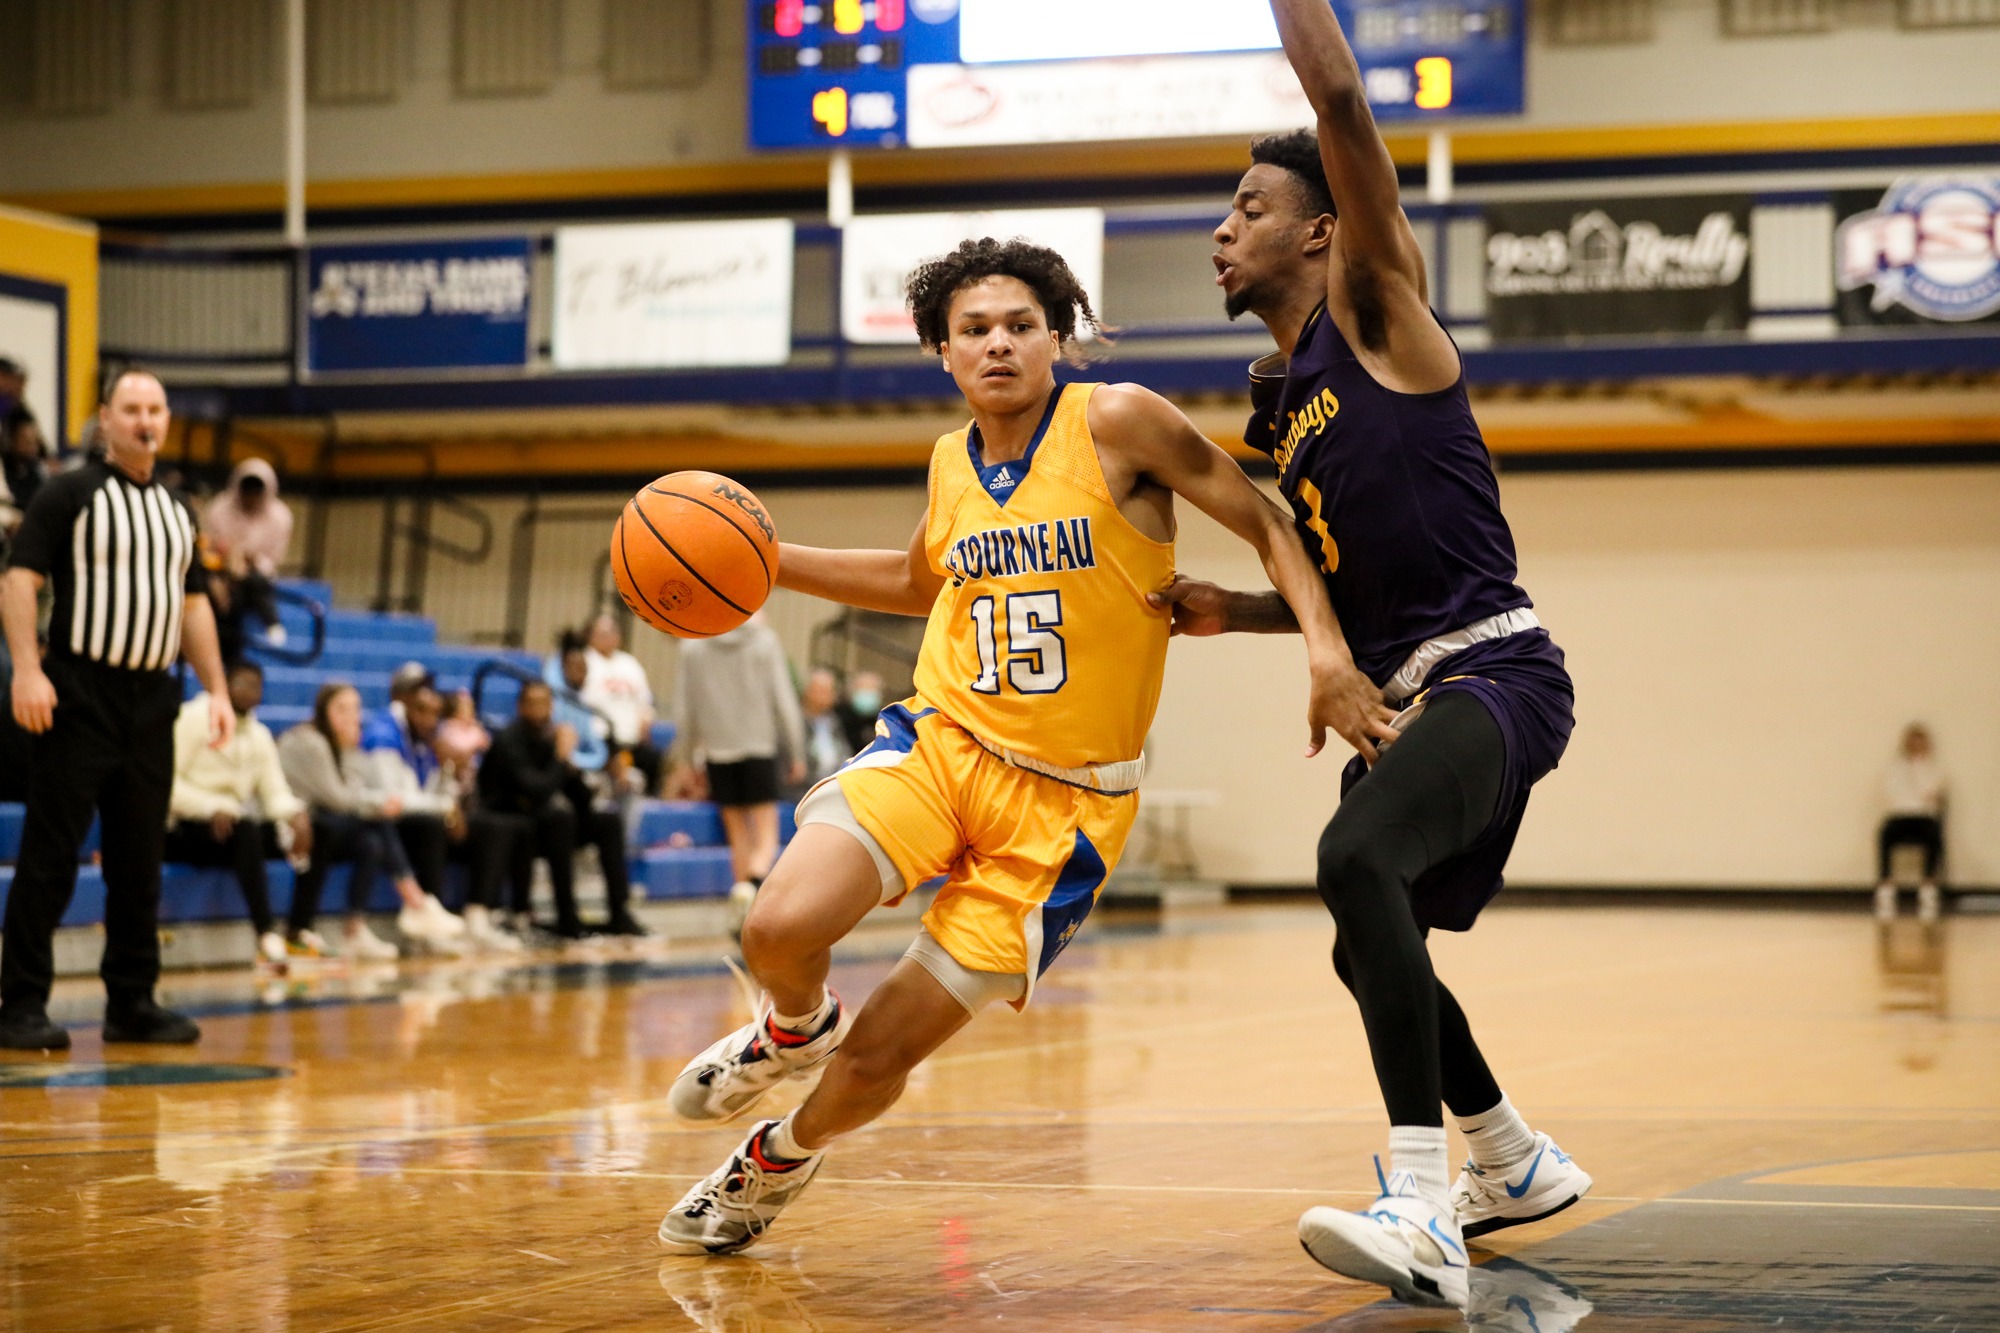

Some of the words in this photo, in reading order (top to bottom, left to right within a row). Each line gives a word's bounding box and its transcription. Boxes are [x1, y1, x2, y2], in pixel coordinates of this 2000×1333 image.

[1274, 387, 1340, 487] owboys
[712, 483, 775, 544] NCAA
[989, 478, 1015, 490] adidas
[970, 589, 1068, 695] 15
